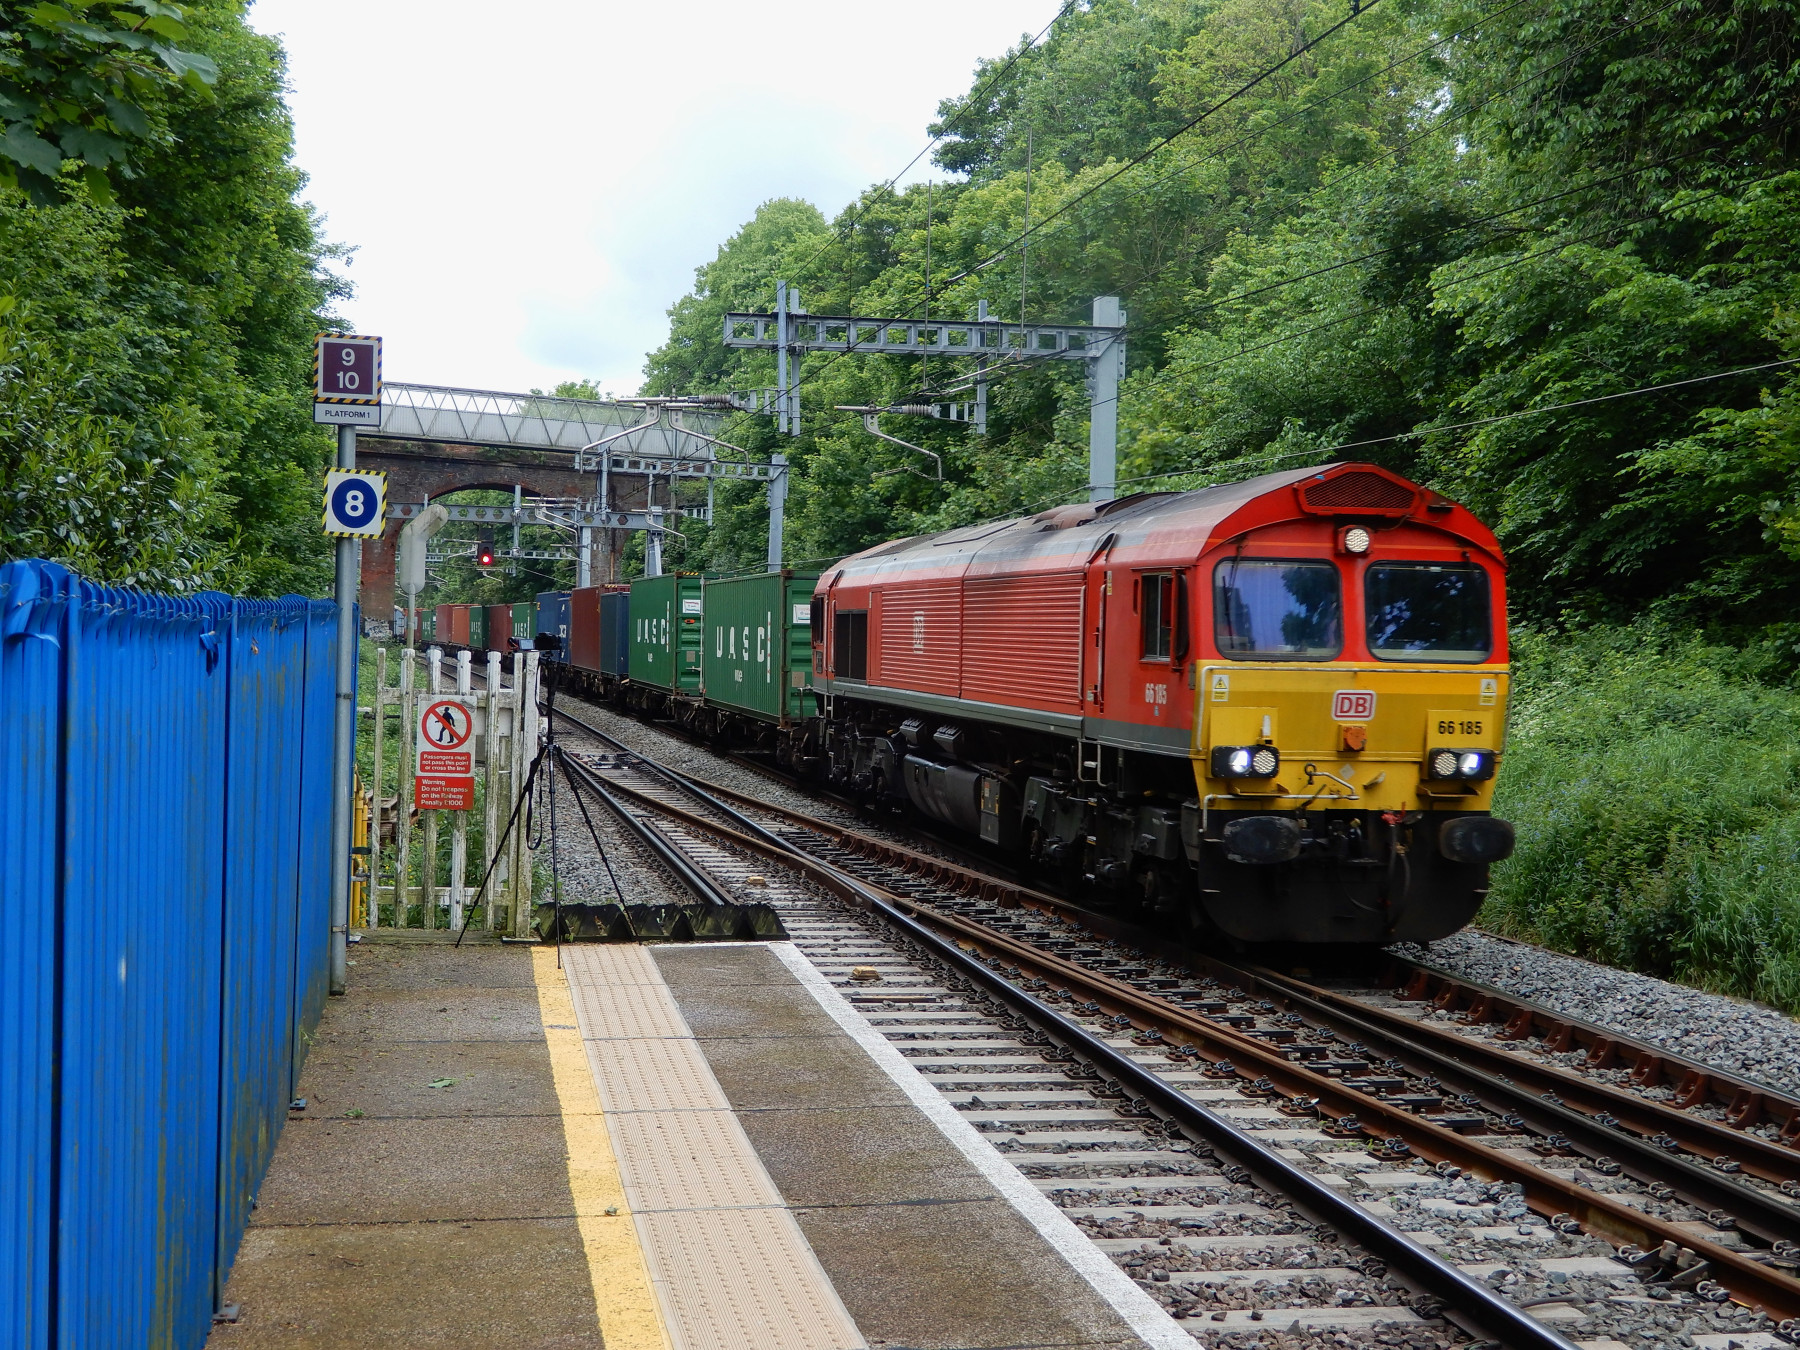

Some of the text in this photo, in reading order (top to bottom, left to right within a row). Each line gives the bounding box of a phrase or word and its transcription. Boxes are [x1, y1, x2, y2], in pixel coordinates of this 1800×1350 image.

[342, 348, 355, 366] 9
[336, 371, 360, 389] 10
[325, 410, 366, 418] PLATFORM
[345, 490, 364, 517] 8
[637, 618, 666, 644] UASC
[716, 626, 765, 662] UASC
[1145, 683, 1167, 705] 66 185
[1339, 696, 1368, 714] DB
[1438, 720, 1482, 735] 66 185
